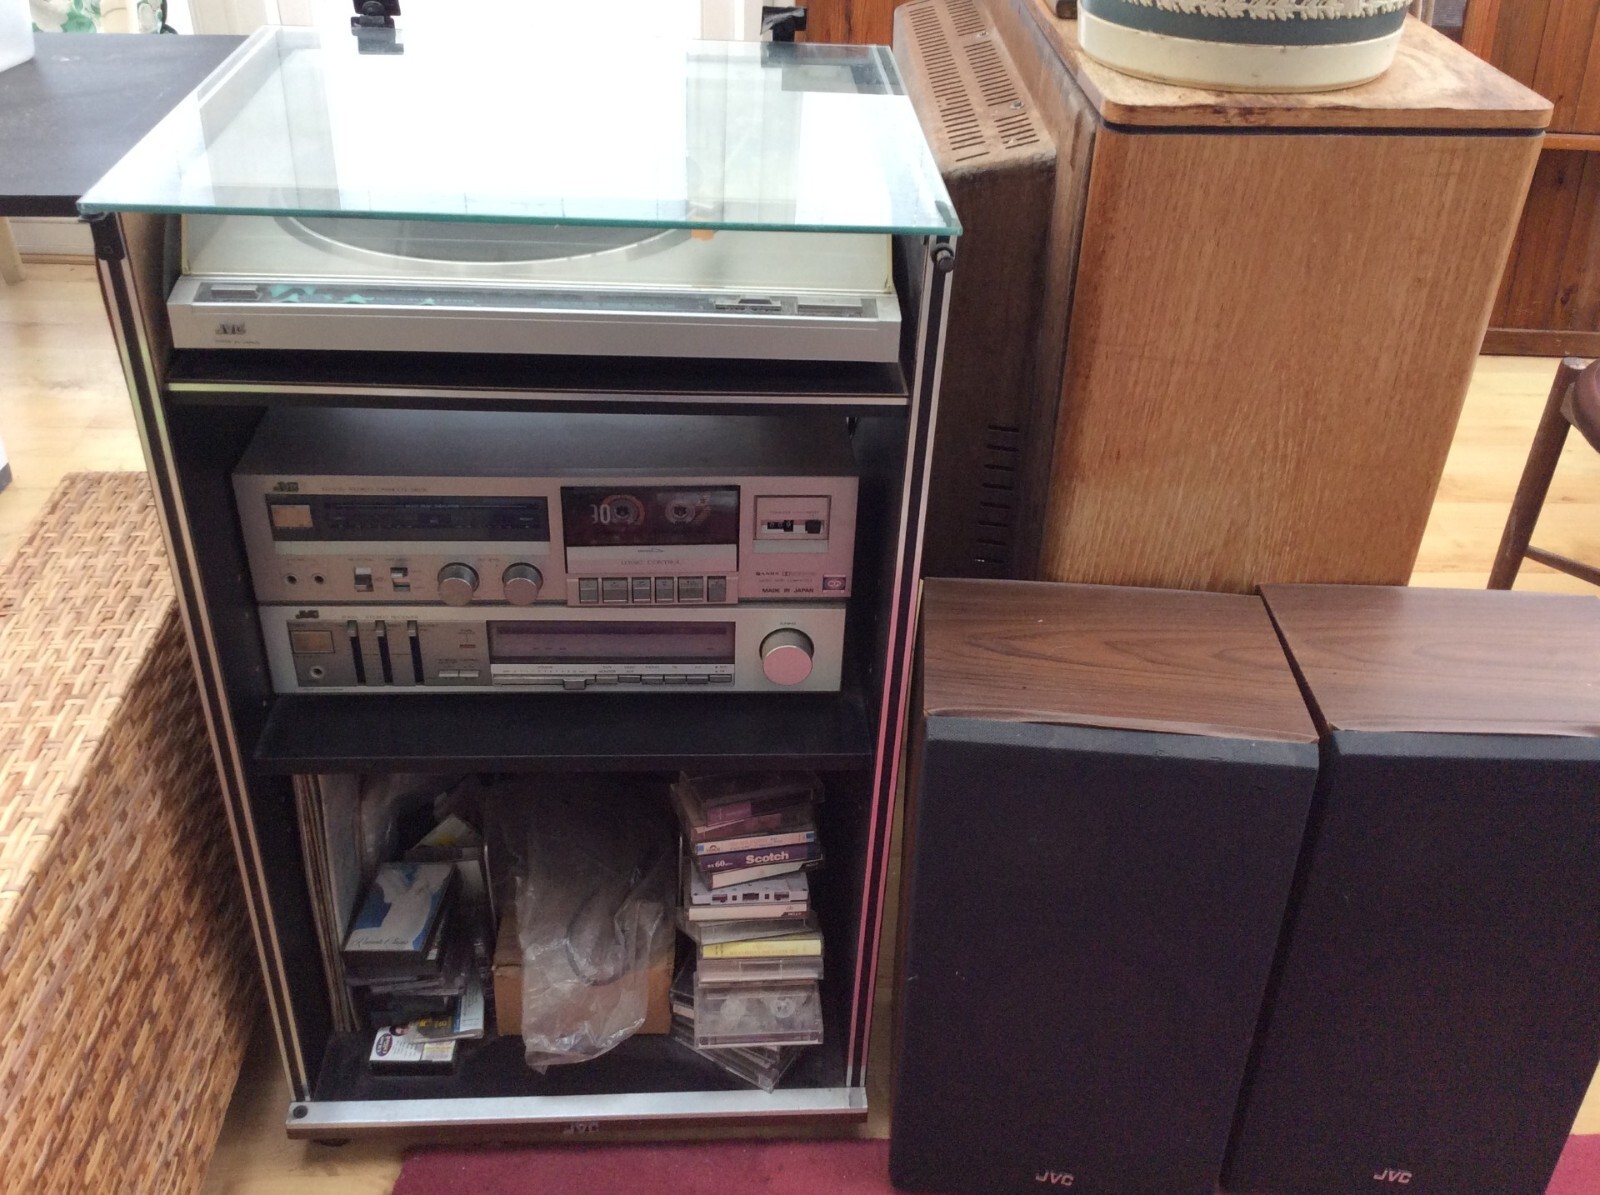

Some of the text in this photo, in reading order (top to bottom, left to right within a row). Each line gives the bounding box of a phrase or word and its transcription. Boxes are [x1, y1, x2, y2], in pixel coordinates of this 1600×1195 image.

[714, 860, 726, 868] 60
[745, 850, 790, 865] Scotch
[1035, 1170, 1075, 1187] JVC
[1373, 1167, 1413, 1184] JVC
